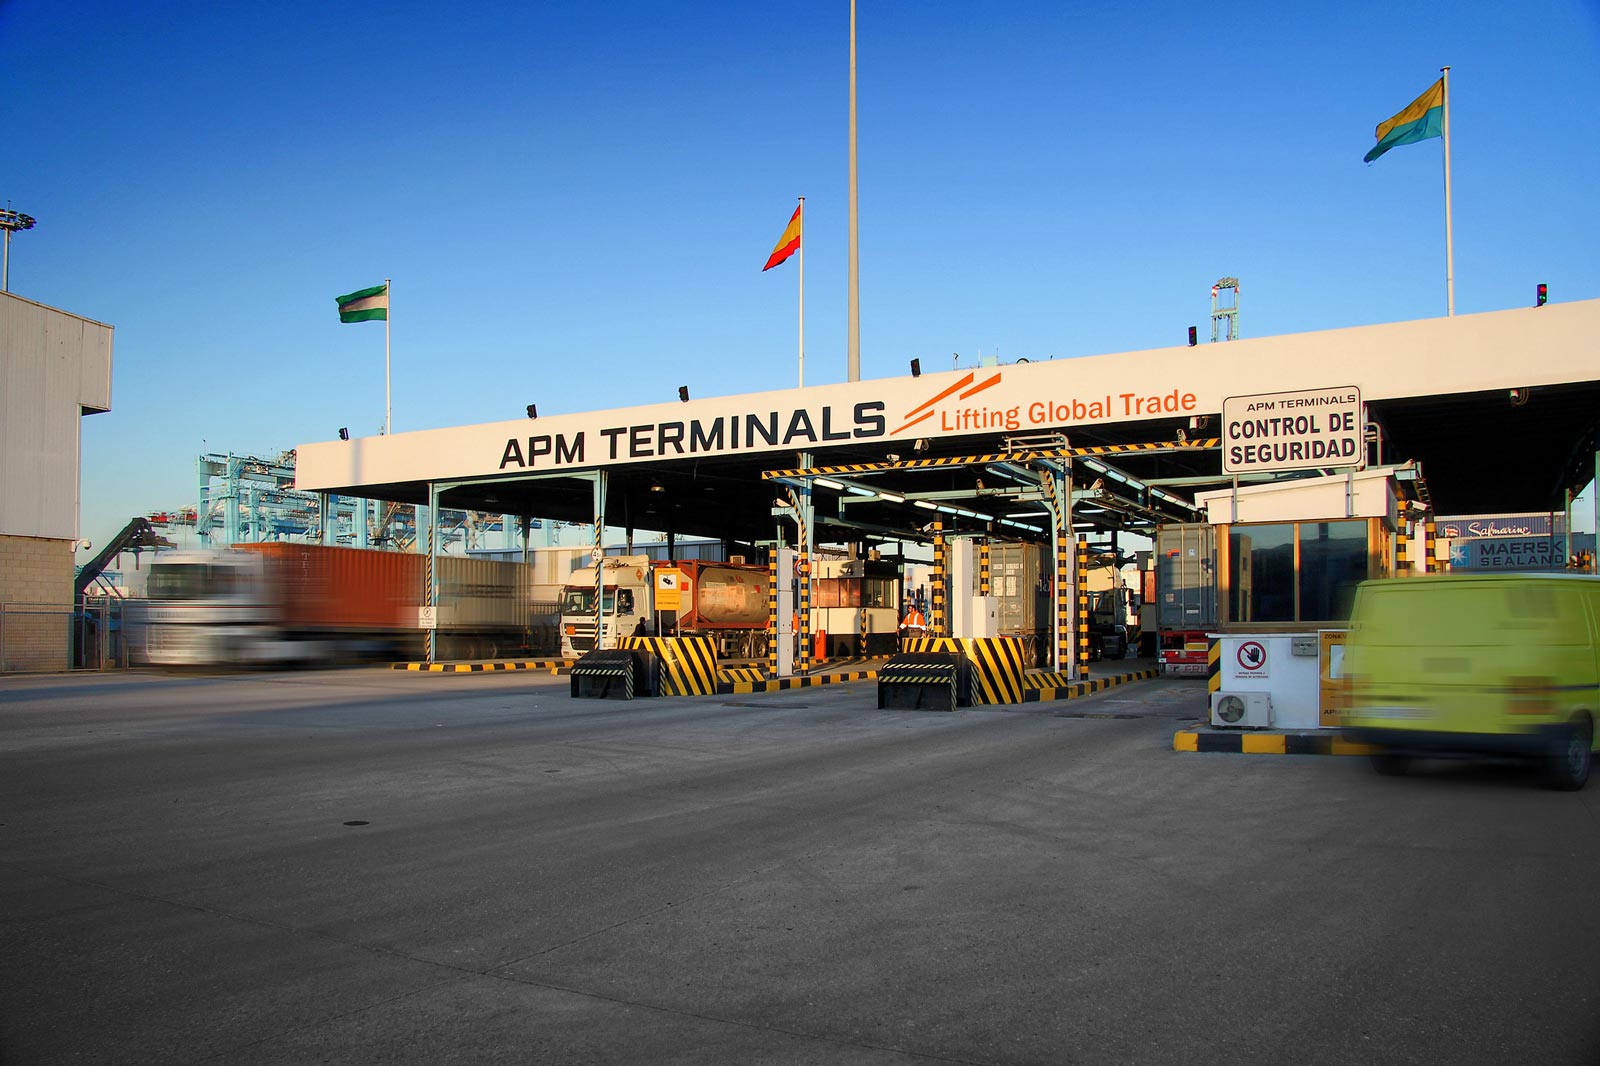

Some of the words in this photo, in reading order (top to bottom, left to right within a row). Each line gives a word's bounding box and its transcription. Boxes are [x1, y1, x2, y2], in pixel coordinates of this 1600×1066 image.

[941, 406, 1020, 431] Lifting
[1028, 395, 1111, 424] Global
[1119, 389, 1197, 416] Trade
[1246, 402, 1275, 412] APM
[1278, 394, 1356, 409] TERMINALS
[499, 431, 585, 470] APM
[600, 401, 886, 460] TERMINALS
[1229, 415, 1321, 440] CONTROL
[1328, 411, 1354, 433] DE
[1230, 438, 1356, 465] SEGURIDAD
[1467, 521, 1531, 538] Safmarine
[1480, 540, 1564, 556] MAERSK
[1480, 554, 1564, 567] SEALAND
